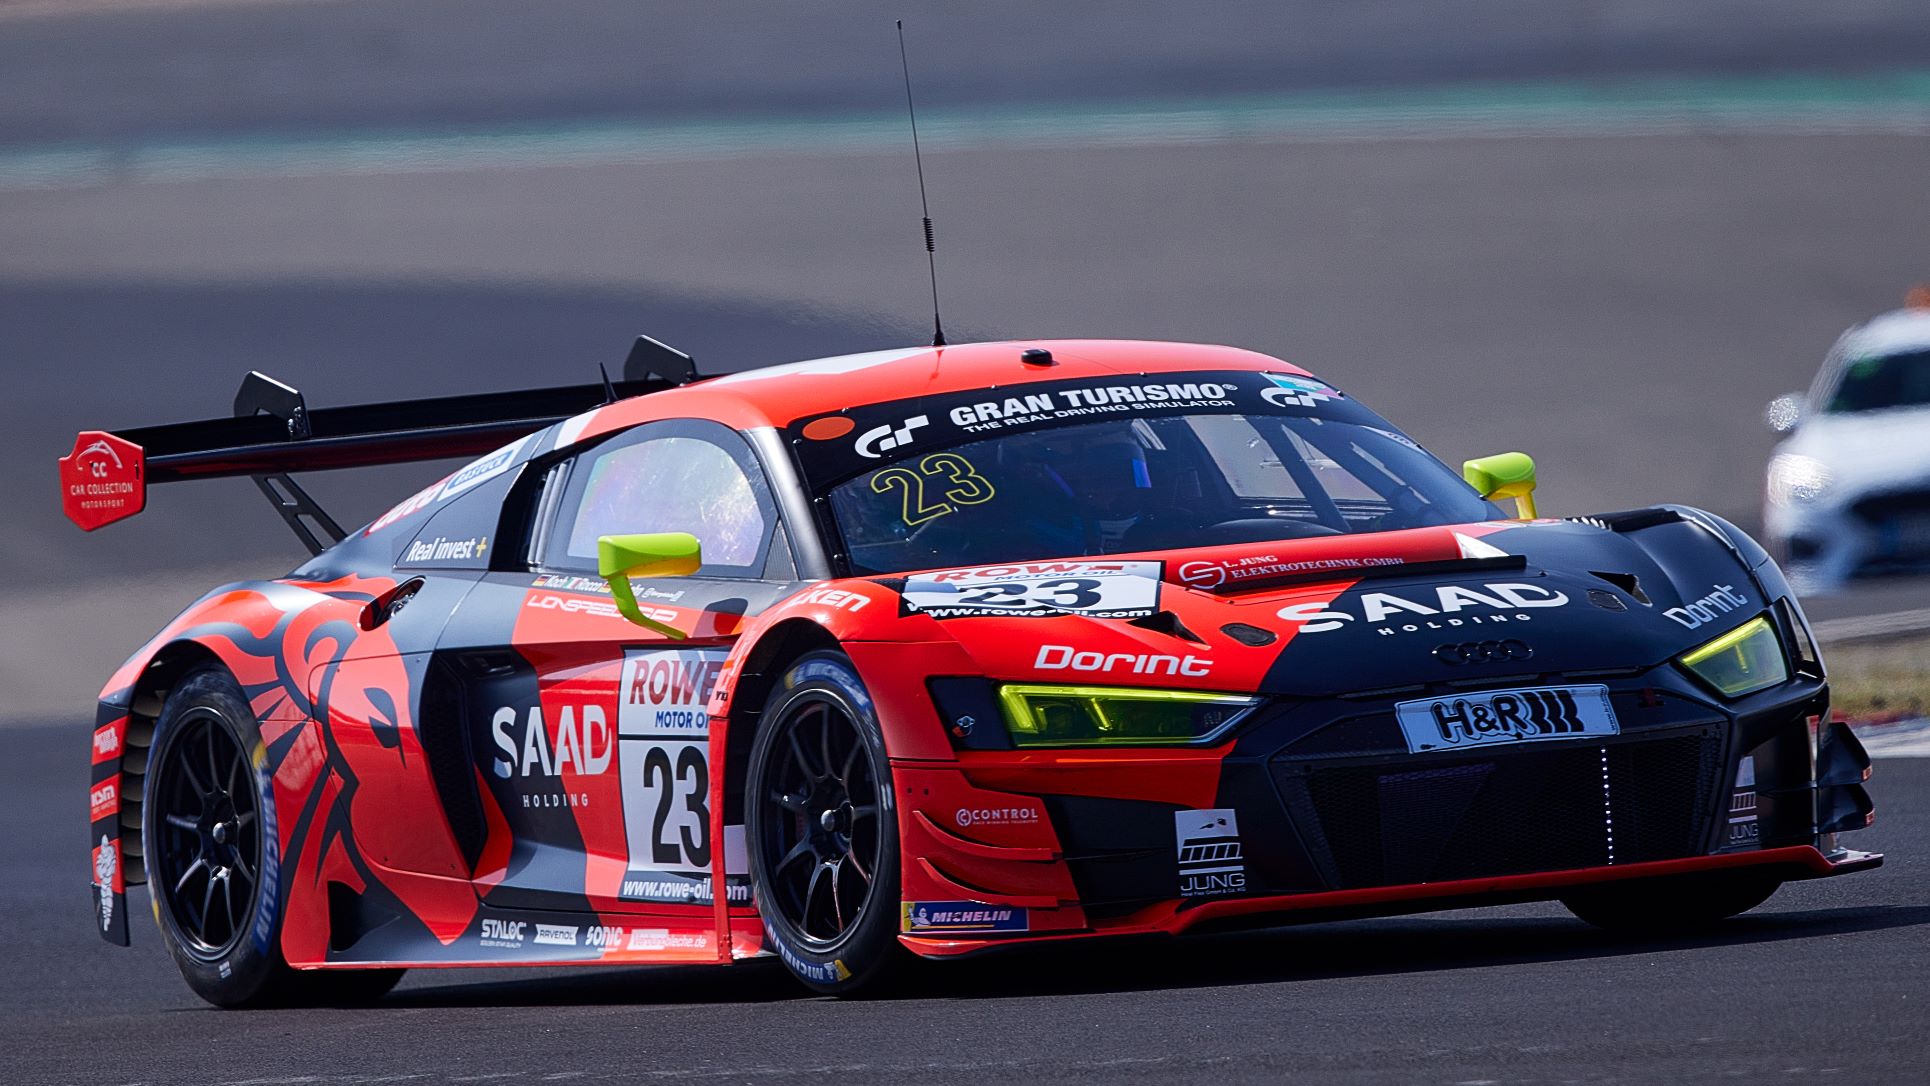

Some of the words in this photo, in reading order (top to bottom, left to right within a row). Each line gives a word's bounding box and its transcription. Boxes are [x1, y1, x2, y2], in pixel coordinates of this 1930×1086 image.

[950, 393, 1055, 426] GRAN
[963, 420, 1003, 433] THE
[1004, 412, 1054, 426] REAL
[1054, 404, 1130, 418] DRIVING
[1131, 400, 1236, 410] SIMULATOR
[70, 484, 85, 496] CAR
[87, 482, 133, 495] COLLECTION
[870, 452, 996, 527] 23
[406, 537, 438, 563] Real
[434, 536, 475, 560] invest
[1239, 554, 1279, 567] JUNG
[994, 572, 1078, 581] MOTOR
[1231, 557, 1361, 579] ELEKTROTECHNIK
[958, 578, 1102, 609] 23
[1276, 582, 1570, 633] SAAD
[1661, 584, 1749, 630] Dorint
[1376, 613, 1532, 636] HOLDING
[1034, 644, 1214, 677] Dorint
[655, 711, 693, 728] MOTOR
[1432, 694, 1530, 741] H&R
[492, 704, 613, 779] SAAD
[522, 792, 589, 808] HOLDING
[643, 745, 713, 868] 23
[972, 808, 1039, 820] CONTROL
[623, 877, 748, 901] www.rowe-oil.om
[1180, 872, 1246, 892] JUNG
[931, 909, 1012, 924] MICHELIN
[481, 918, 527, 941] STALOC
